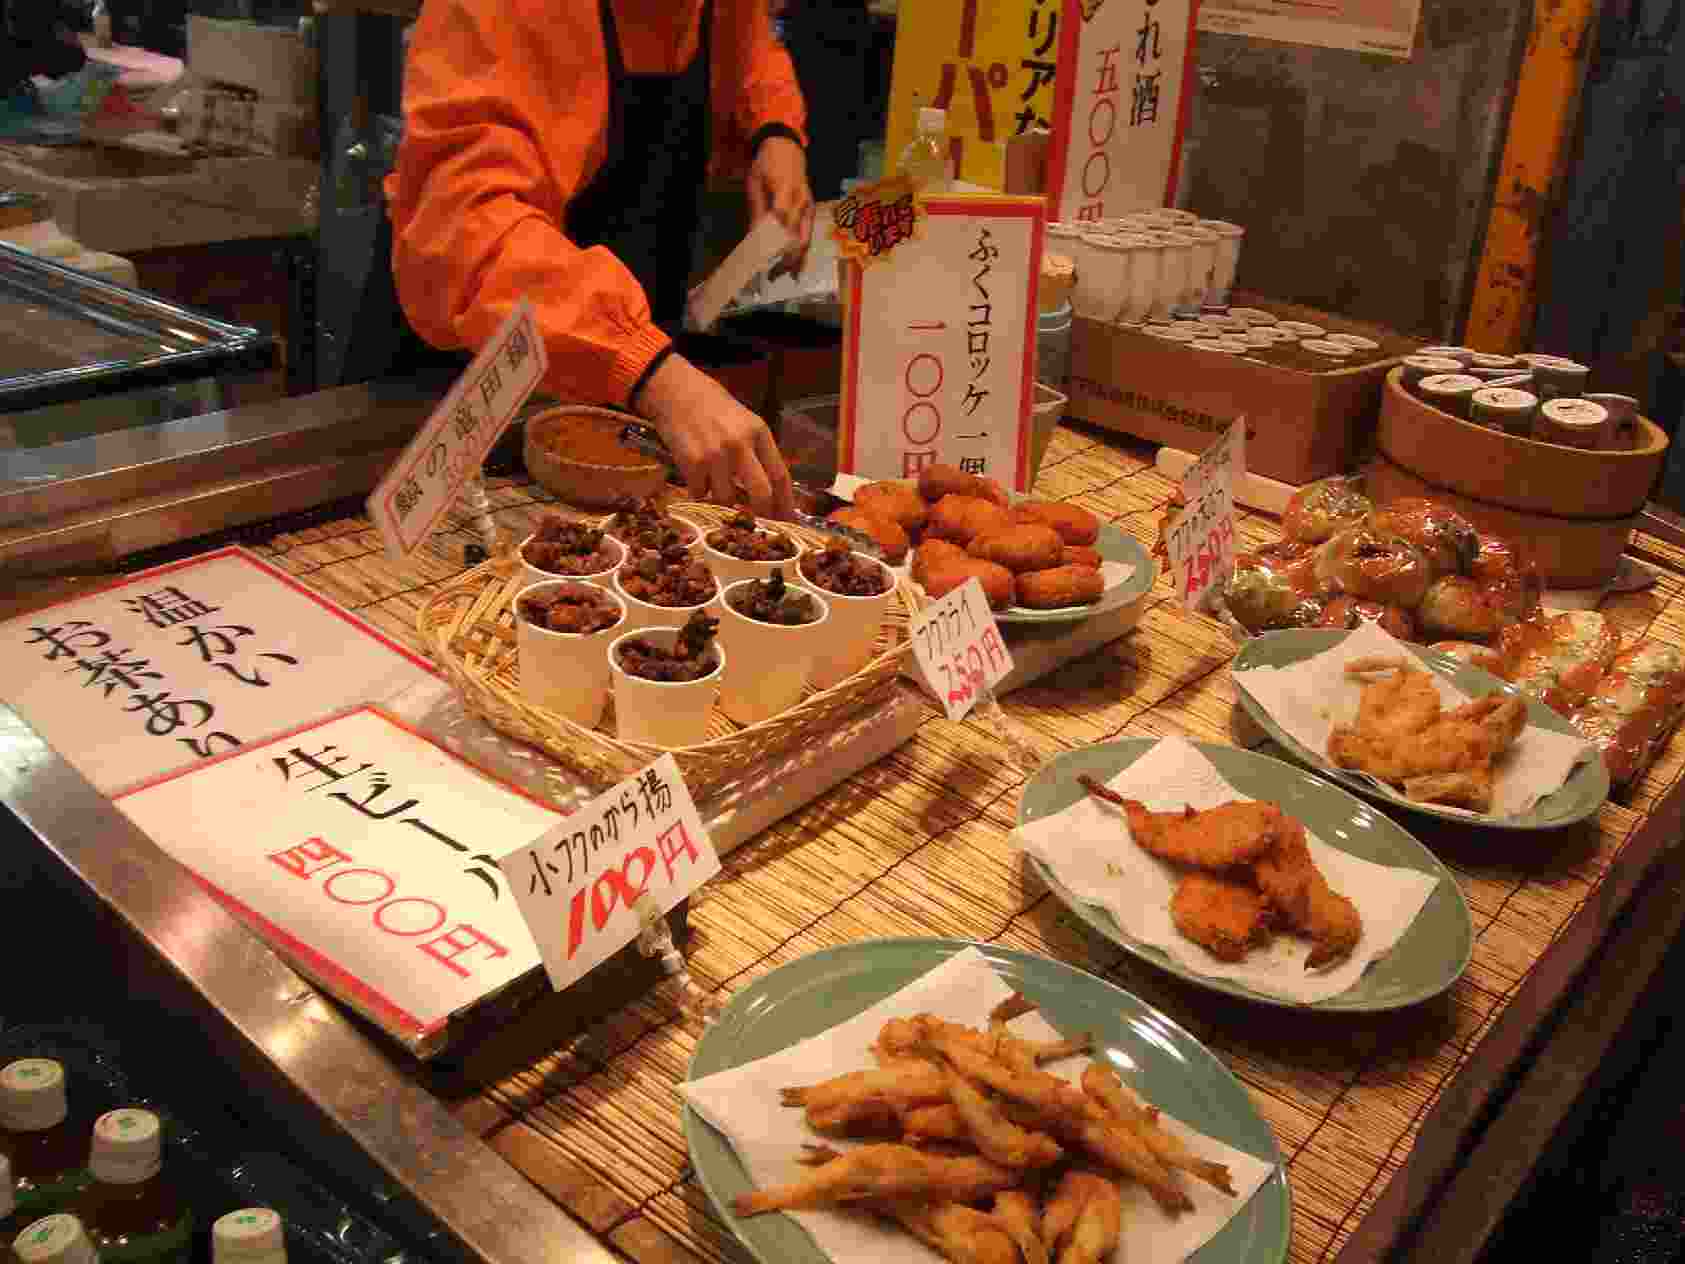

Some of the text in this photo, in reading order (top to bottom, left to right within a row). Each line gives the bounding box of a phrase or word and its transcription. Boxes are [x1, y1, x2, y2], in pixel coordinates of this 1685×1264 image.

[1129, 0, 1163, 127] れ酒
[119, 586, 299, 688] 温かい
[567, 819, 699, 960] 100円
